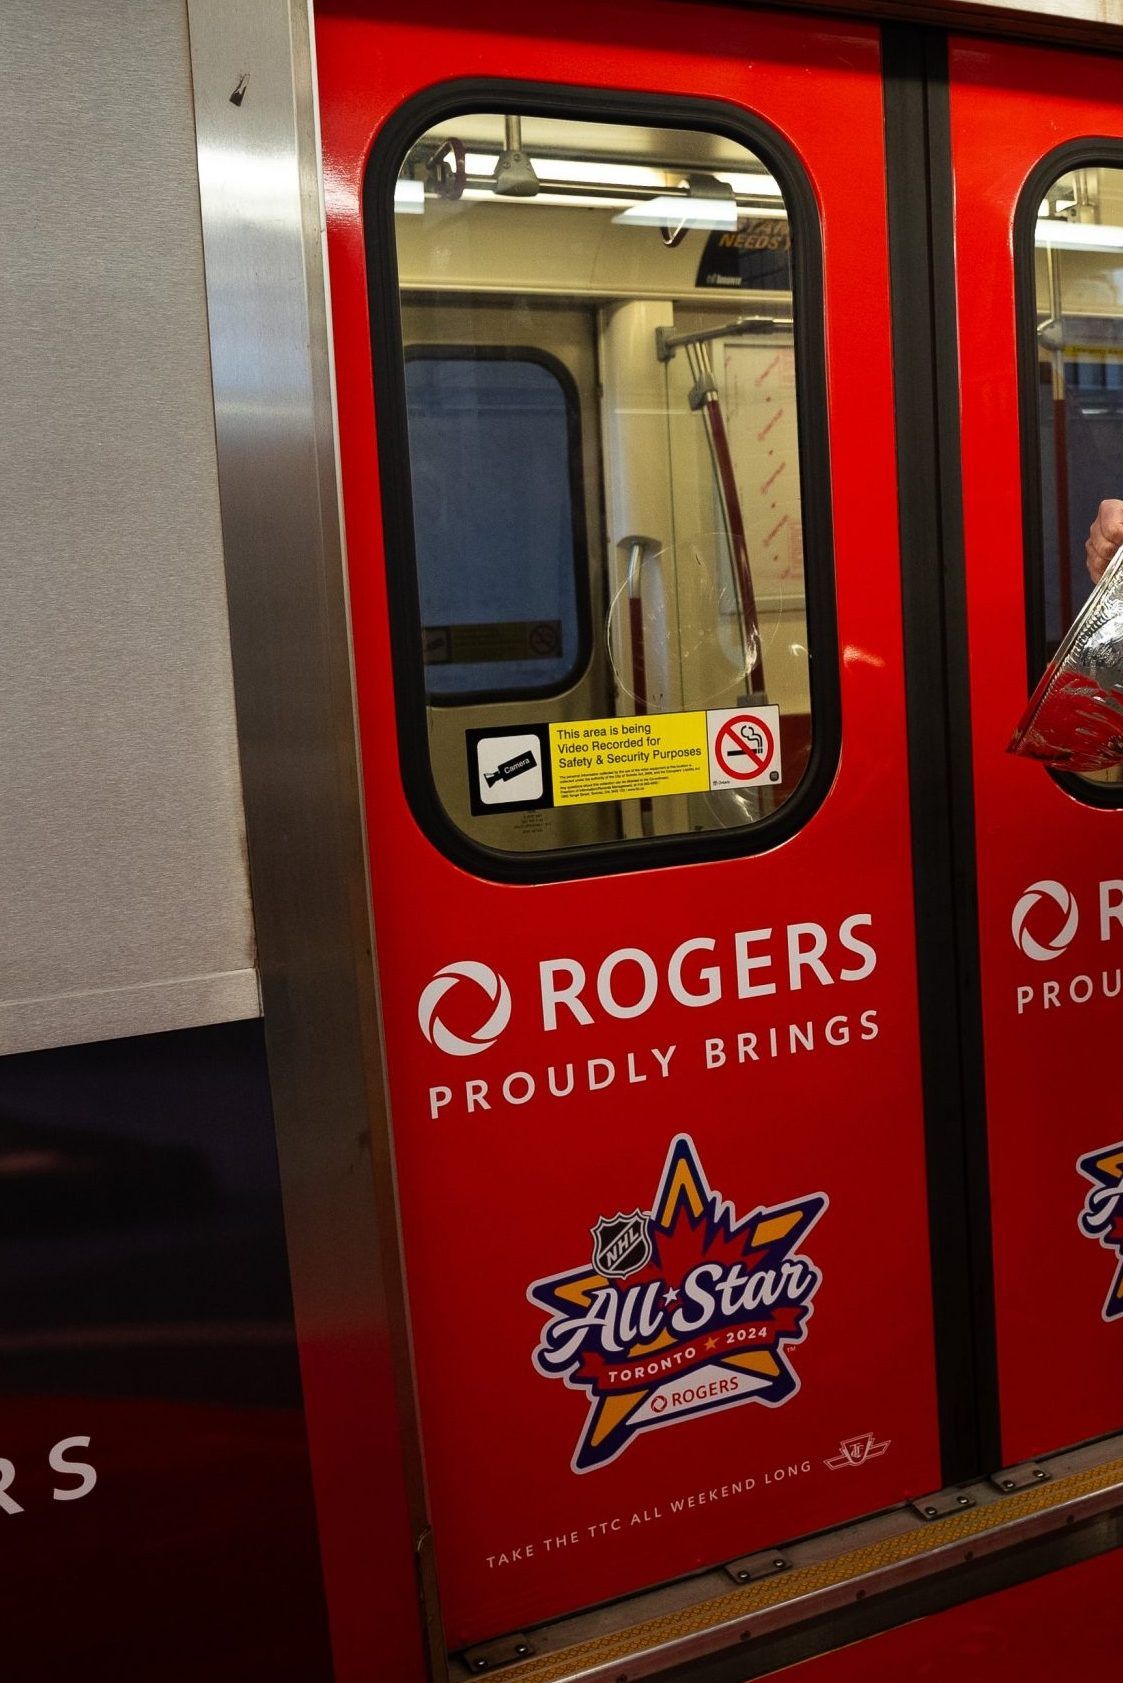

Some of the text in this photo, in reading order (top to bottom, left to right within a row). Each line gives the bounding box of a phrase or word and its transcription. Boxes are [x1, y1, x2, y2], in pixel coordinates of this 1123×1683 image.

[557, 724, 651, 740] This area is being
[557, 736, 661, 754] Video Recorded for
[503, 758, 530, 774] Camera
[559, 748, 702, 769] Safety & Security Purposes
[539, 912, 877, 1032] ROGERS
[429, 1009, 880, 1119] PROUDLY BRINGS
[606, 1226, 640, 1268] NHL
[543, 1259, 810, 1363] All Star
[608, 1326, 769, 1384] TORONTO 2024
[671, 1376, 740, 1407] ROGERS
[486, 1460, 811, 1568] TAKE THE TTC ALL WEEKEND LONG
